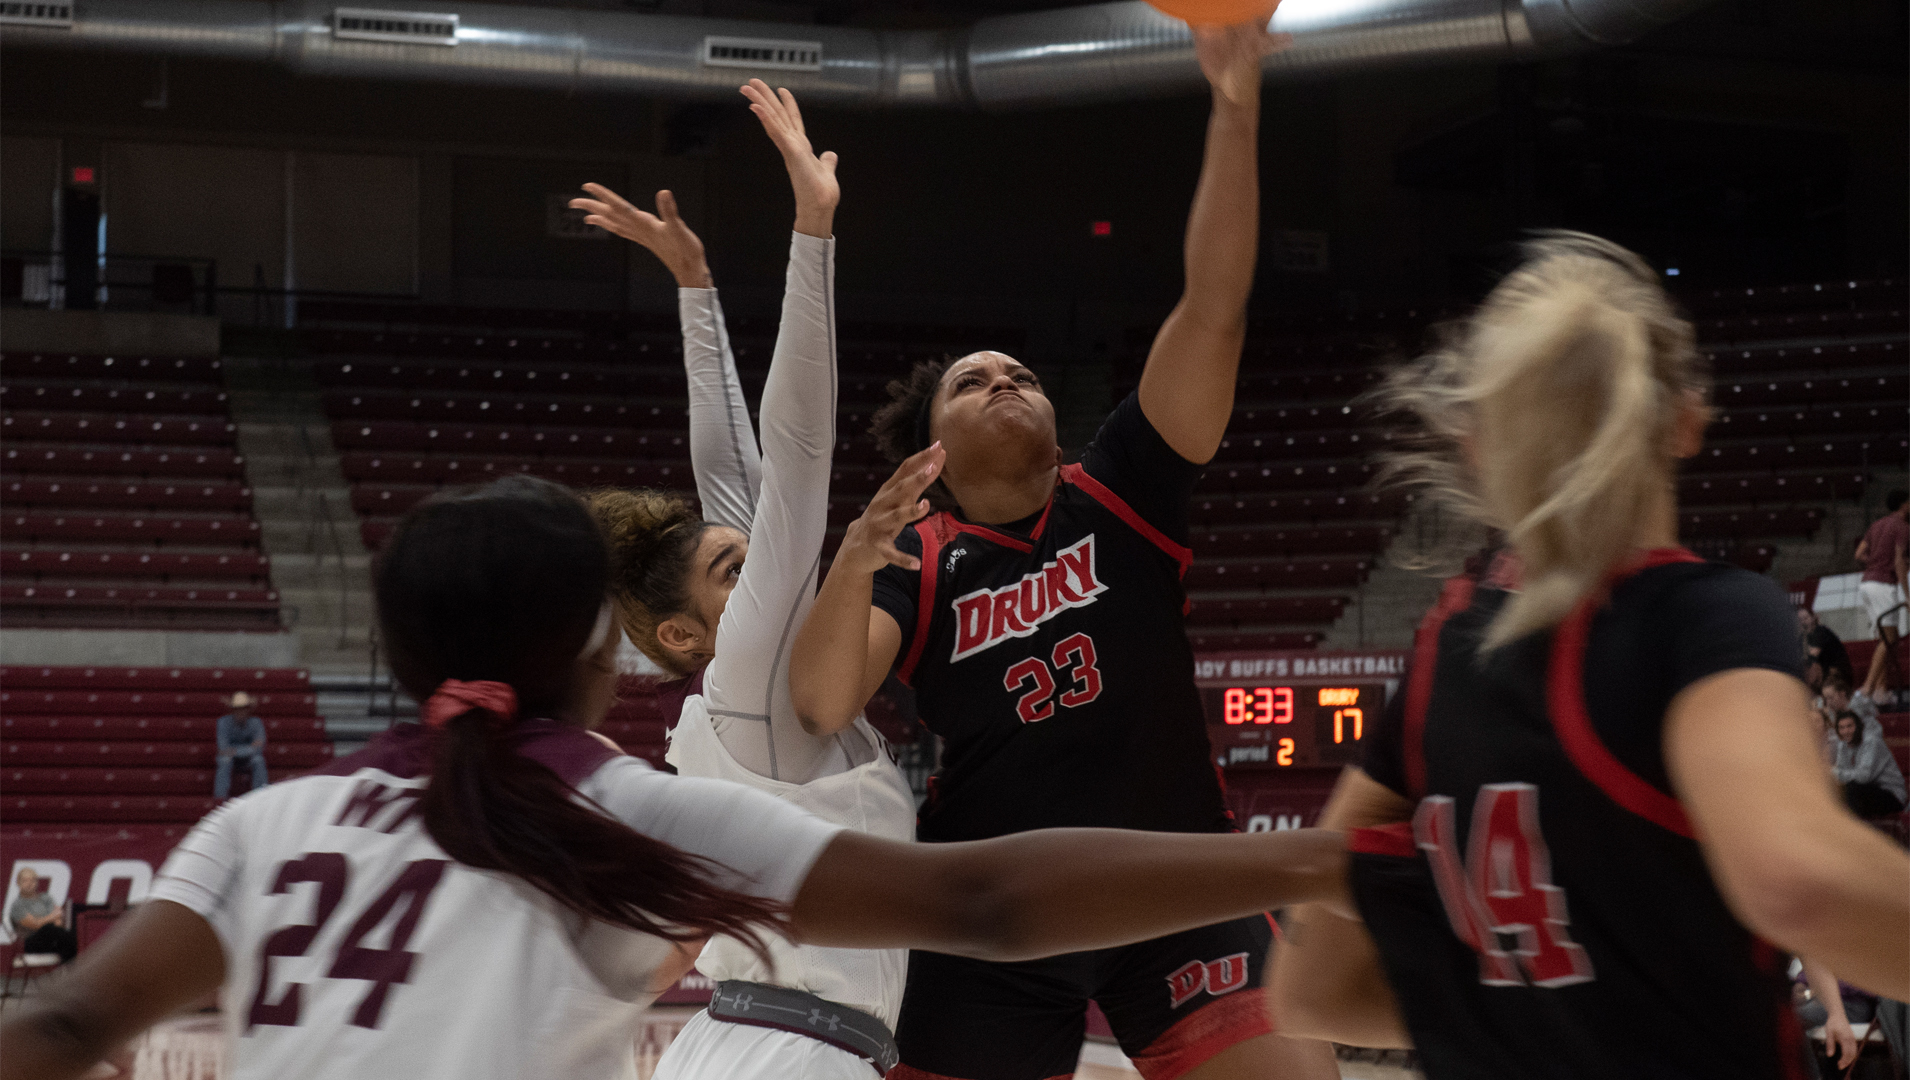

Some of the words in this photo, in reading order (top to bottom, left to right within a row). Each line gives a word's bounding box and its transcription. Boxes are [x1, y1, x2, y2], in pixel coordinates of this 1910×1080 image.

[951, 533, 1110, 664] DRURY
[1003, 632, 1103, 724] 23
[1230, 659, 1288, 677] BUFFS
[1224, 687, 1294, 724] 8:33
[1333, 708, 1363, 744] 17
[1276, 737, 1295, 766] 2
[1411, 781, 1597, 988] 14
[241, 852, 447, 1036] 24
[1164, 951, 1250, 1010] DU
